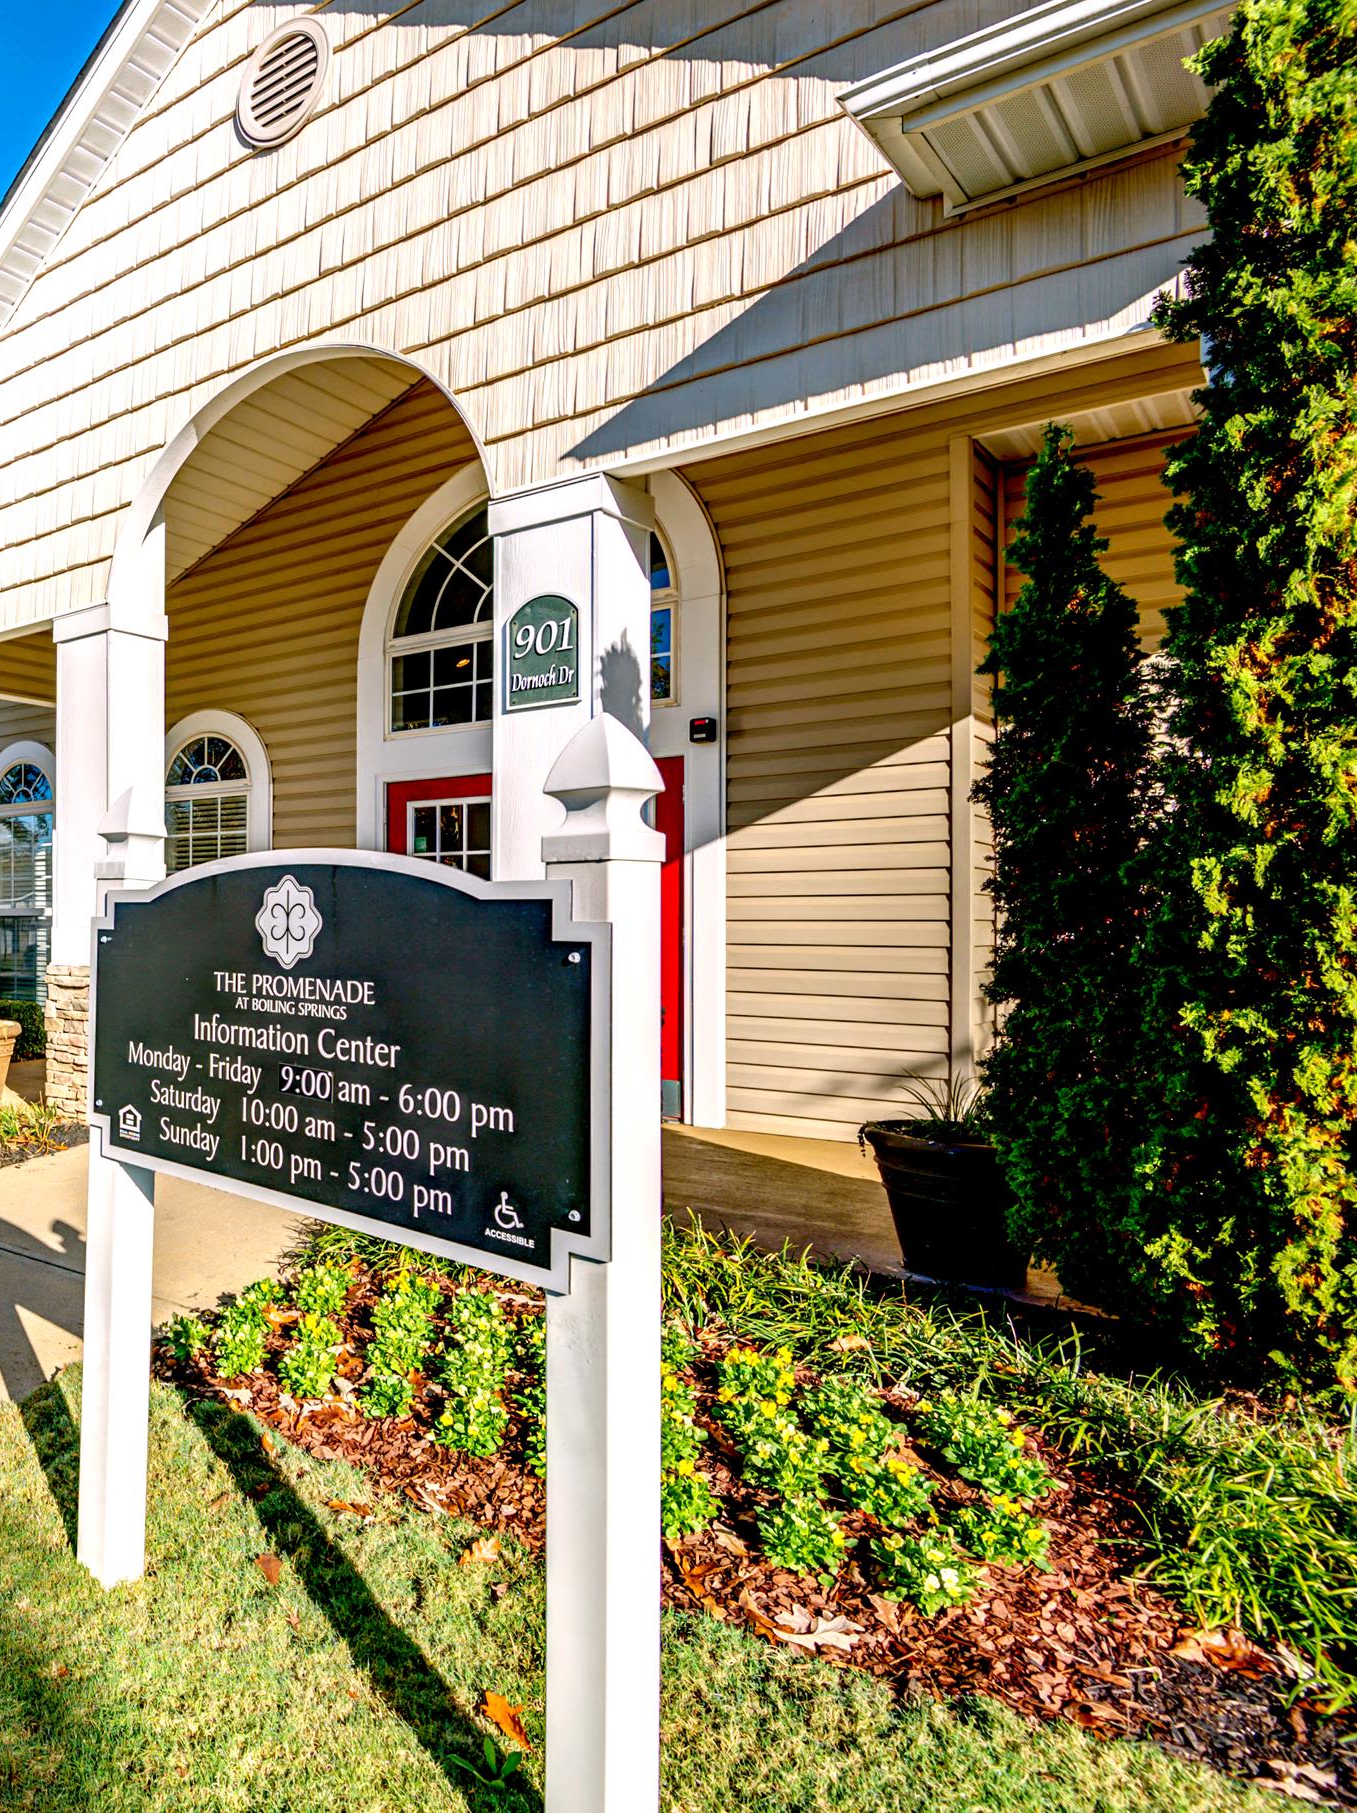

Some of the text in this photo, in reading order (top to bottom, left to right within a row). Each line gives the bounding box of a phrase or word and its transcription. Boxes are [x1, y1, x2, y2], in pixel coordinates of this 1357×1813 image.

[514, 616, 573, 660] 901
[511, 664, 575, 692] Dornoch Dr
[214, 971, 376, 1006] THE PROMENADE
[235, 997, 348, 1021] AT BOILING SPRINGS
[194, 1013, 401, 1069] Information Center
[128, 1040, 191, 1082] Monday
[209, 1053, 263, 1095] Friday
[281, 1065, 333, 1100] 9:00
[337, 1080, 371, 1106] am
[398, 1083, 461, 1123] 6:00
[470, 1102, 515, 1138] pm
[150, 1079, 221, 1125] Saturday
[242, 1096, 299, 1133] 10:00
[304, 1116, 336, 1142] am
[362, 1121, 420, 1160] 5:00
[429, 1141, 470, 1177] pm
[159, 1117, 220, 1162] Sunday
[241, 1135, 284, 1170] 1:00
[290, 1153, 322, 1184] pm
[347, 1161, 404, 1201] 5:00
[413, 1183, 453, 1218] pm
[484, 1227, 536, 1249] ACCESSIBLE
